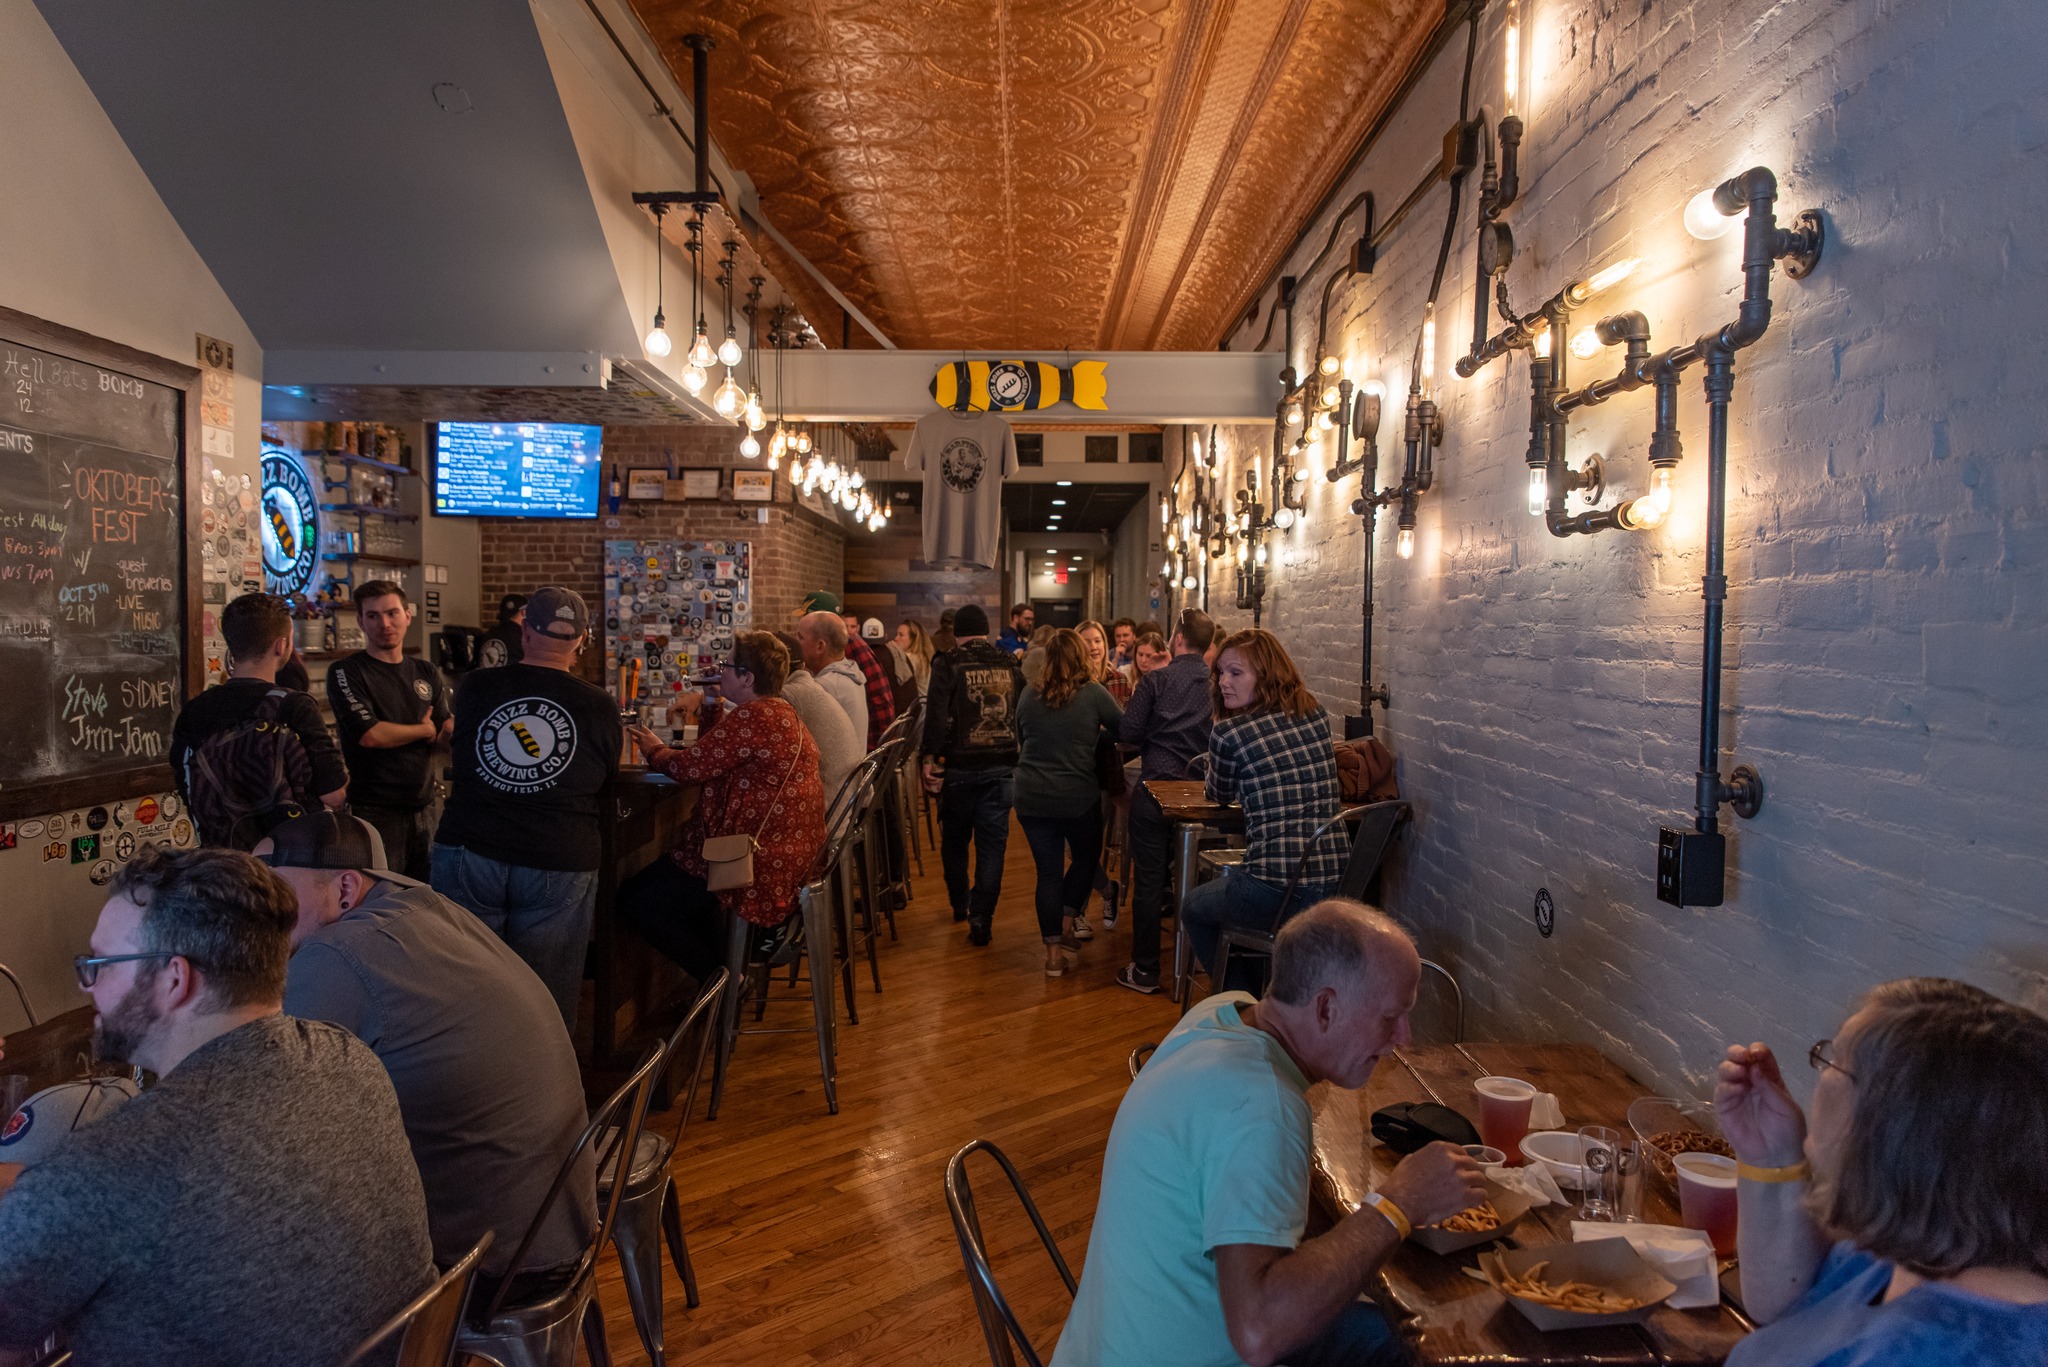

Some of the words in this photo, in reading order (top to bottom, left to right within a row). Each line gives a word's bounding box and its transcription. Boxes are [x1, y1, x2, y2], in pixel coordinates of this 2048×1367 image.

[5, 350, 45, 383] Hell
[97, 370, 144, 399] BOMB
[16, 379, 33, 396] 24
[19, 398, 34, 413] 12
[279, 462, 315, 522] BOMB
[0, 509, 25, 528] est
[91, 508, 147, 546] FEST
[4, 537, 34, 554] Bros
[36, 541, 62, 559] 3pm
[26, 563, 54, 584] 7pm
[118, 557, 148, 579] guest
[126, 573, 173, 592] breweries
[117, 594, 145, 610] LIVE
[65, 605, 75, 621] 2
[77, 604, 96, 628] PM
[132, 611, 161, 632] MUSIC
[61, 674, 108, 720] Steve
[120, 676, 176, 712] SYDNEY
[487, 703, 529, 731] BUZZ
[535, 703, 571, 740] BOMB
[482, 743, 539, 780] BREWING
[541, 755, 565, 774] CO.
[546, 779, 559, 789] IL
[136, 825, 154, 835] FULL
[154, 823, 172, 833] MILE
[43, 841, 68, 863] LBB
